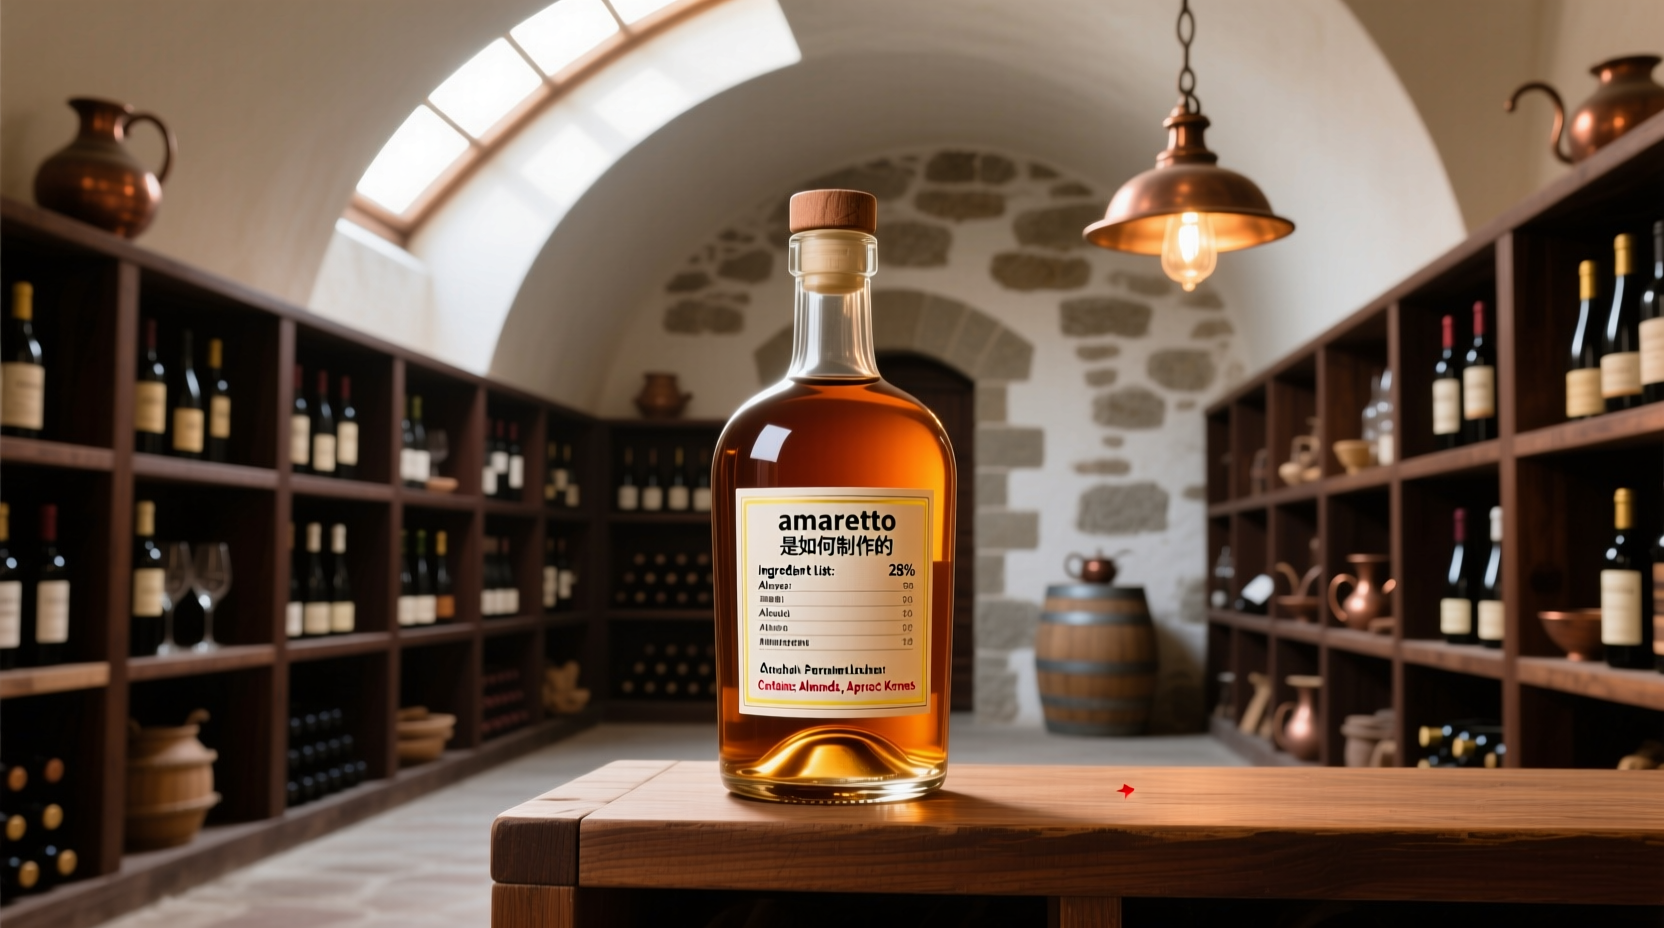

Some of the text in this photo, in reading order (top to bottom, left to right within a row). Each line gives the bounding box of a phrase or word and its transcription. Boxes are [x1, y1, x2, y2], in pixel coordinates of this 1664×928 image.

[779, 510, 896, 531] amaretto
[780, 535, 893, 556] 是如何制作的
[888, 563, 915, 576] 28%
